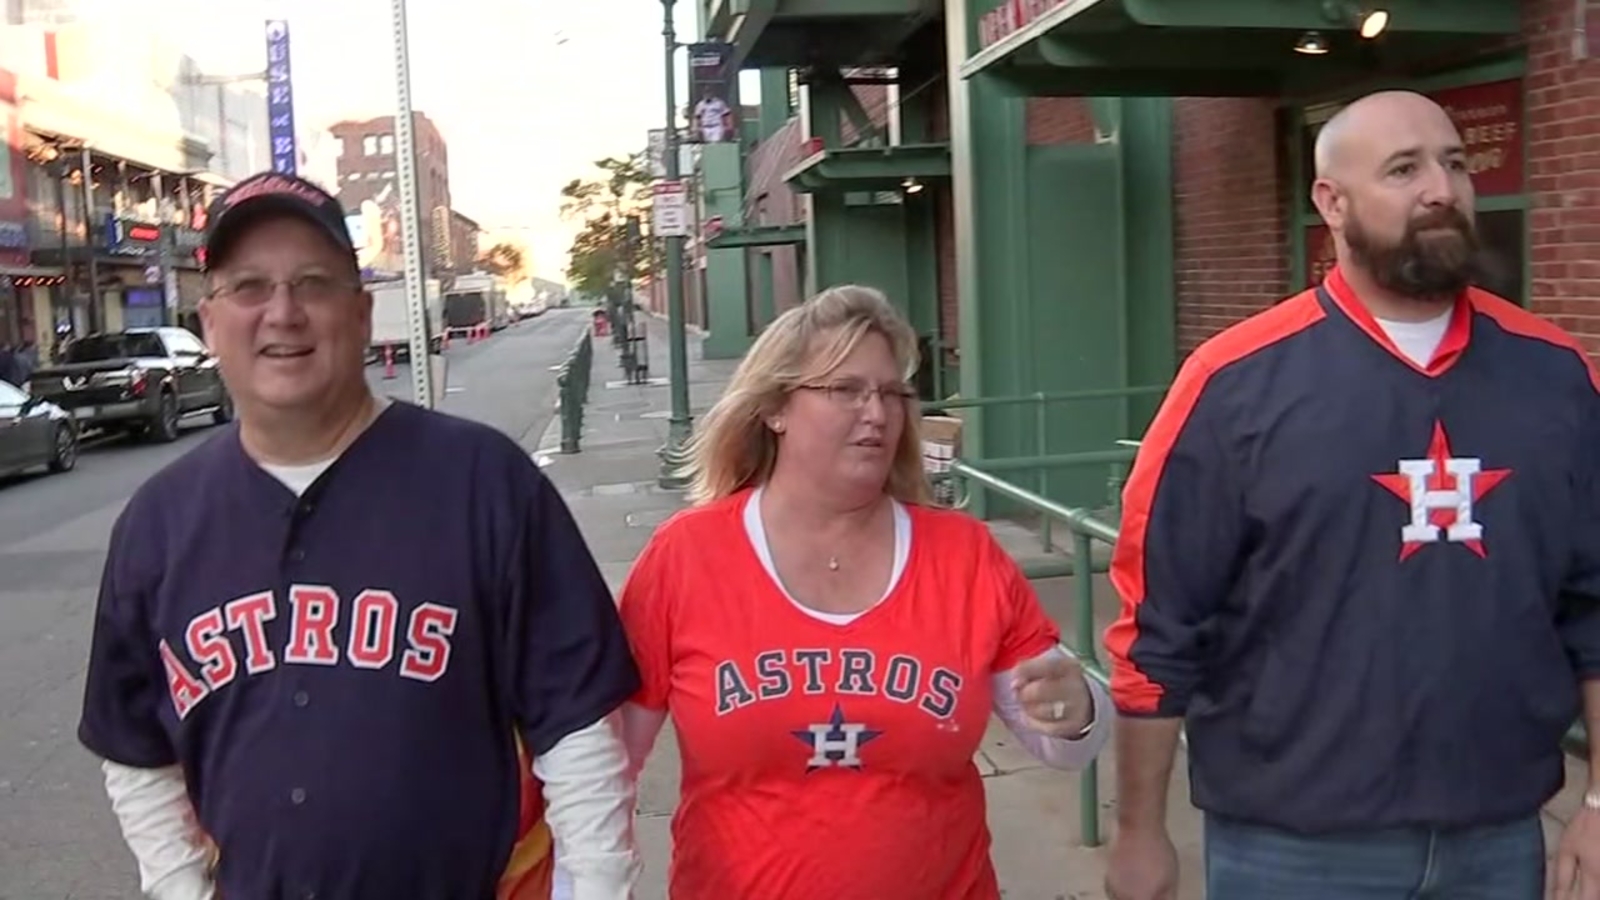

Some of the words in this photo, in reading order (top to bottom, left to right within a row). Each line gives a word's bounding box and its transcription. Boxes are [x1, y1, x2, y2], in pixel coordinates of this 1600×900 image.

[1397, 458, 1484, 543] H
[158, 583, 458, 721] ASTROS
[715, 647, 963, 719] ASTROS
[807, 723, 867, 767] H
